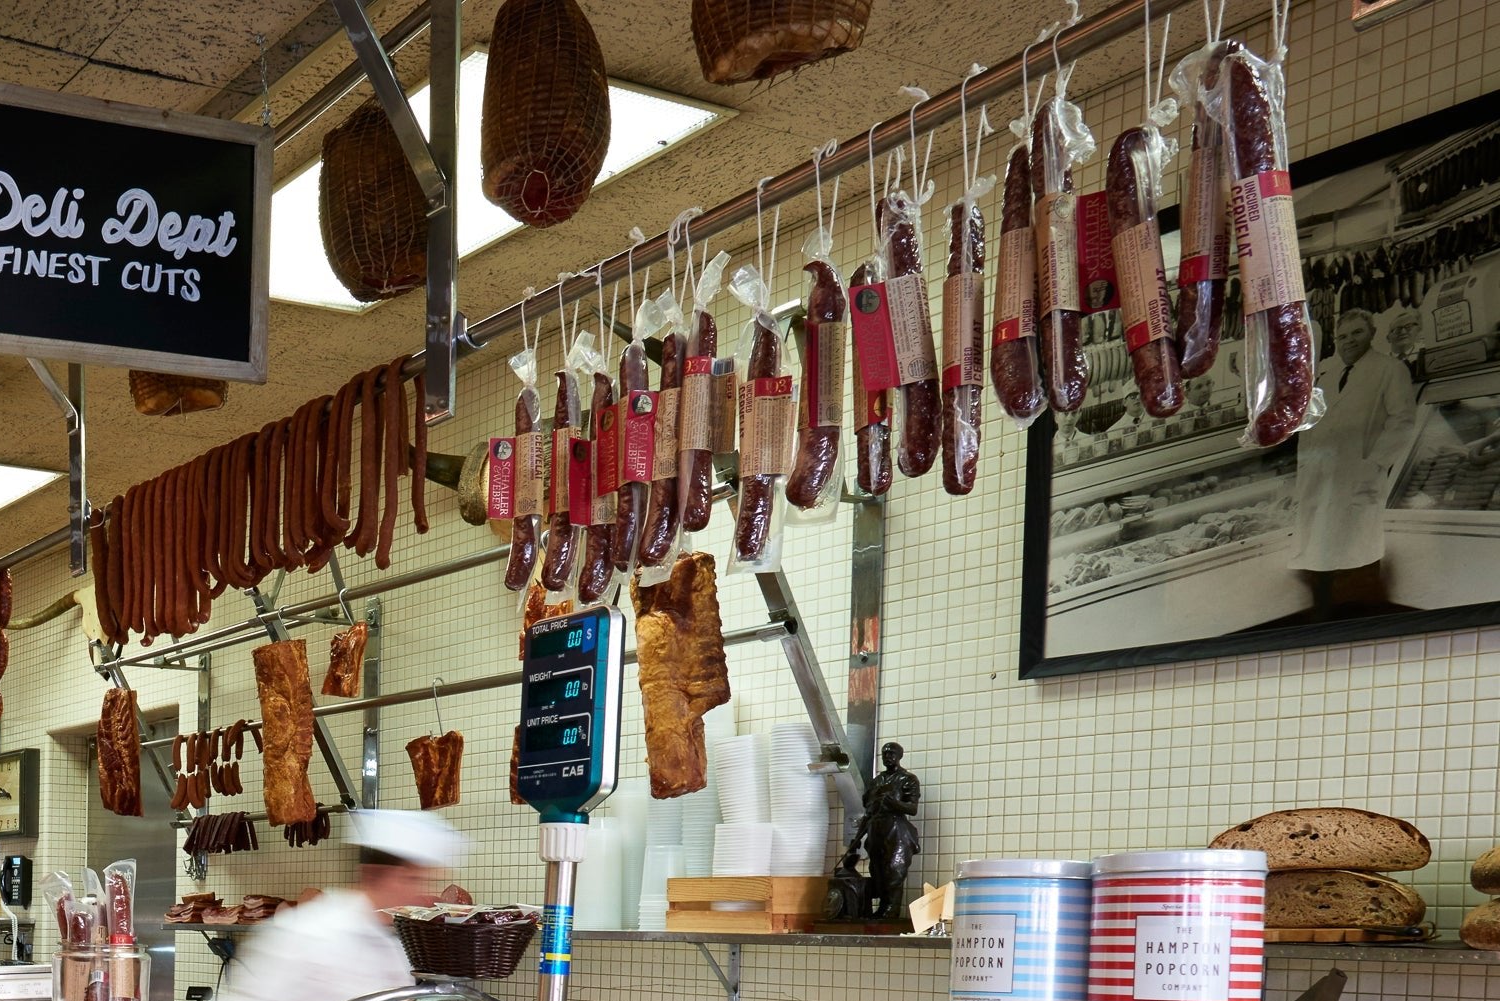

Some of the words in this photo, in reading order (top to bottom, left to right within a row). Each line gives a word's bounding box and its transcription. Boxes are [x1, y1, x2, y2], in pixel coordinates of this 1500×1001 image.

[1244, 181, 1260, 222] UNCURED
[101, 188, 238, 260] Dept
[1086, 198, 1100, 279] SCHALLER
[1231, 185, 1253, 258] CERVELAT
[1212, 234, 1224, 274] UNCURED
[120, 261, 201, 302] CUTS
[907, 300, 921, 347] NATURAL
[1021, 299, 1032, 334] UNCURED
[1148, 298, 1163, 336] UNCURED
[963, 346, 973, 381] UNCURED
[972, 319, 983, 382] CERVELAT
[745, 384, 754, 413] UNCURED
[534, 434, 543, 479] CERVELAT
[500, 461, 511, 515] SCHALLER
[532, 623, 550, 635] TOTAL
[550, 618, 569, 631] PRICE
[529, 670, 552, 683] WEIGHT
[527, 717, 540, 728] UNIT
[541, 714, 559, 724] PRICE
[561, 764, 584, 778] CAS
[956, 937, 1005, 949] HAMPTON
[971, 923, 982, 931] THE
[1176, 926, 1192, 934] THE
[955, 956, 1003, 969] POPCORN
[1145, 941, 1221, 955] HAMPTON
[1145, 963, 1220, 977] POPCORN
